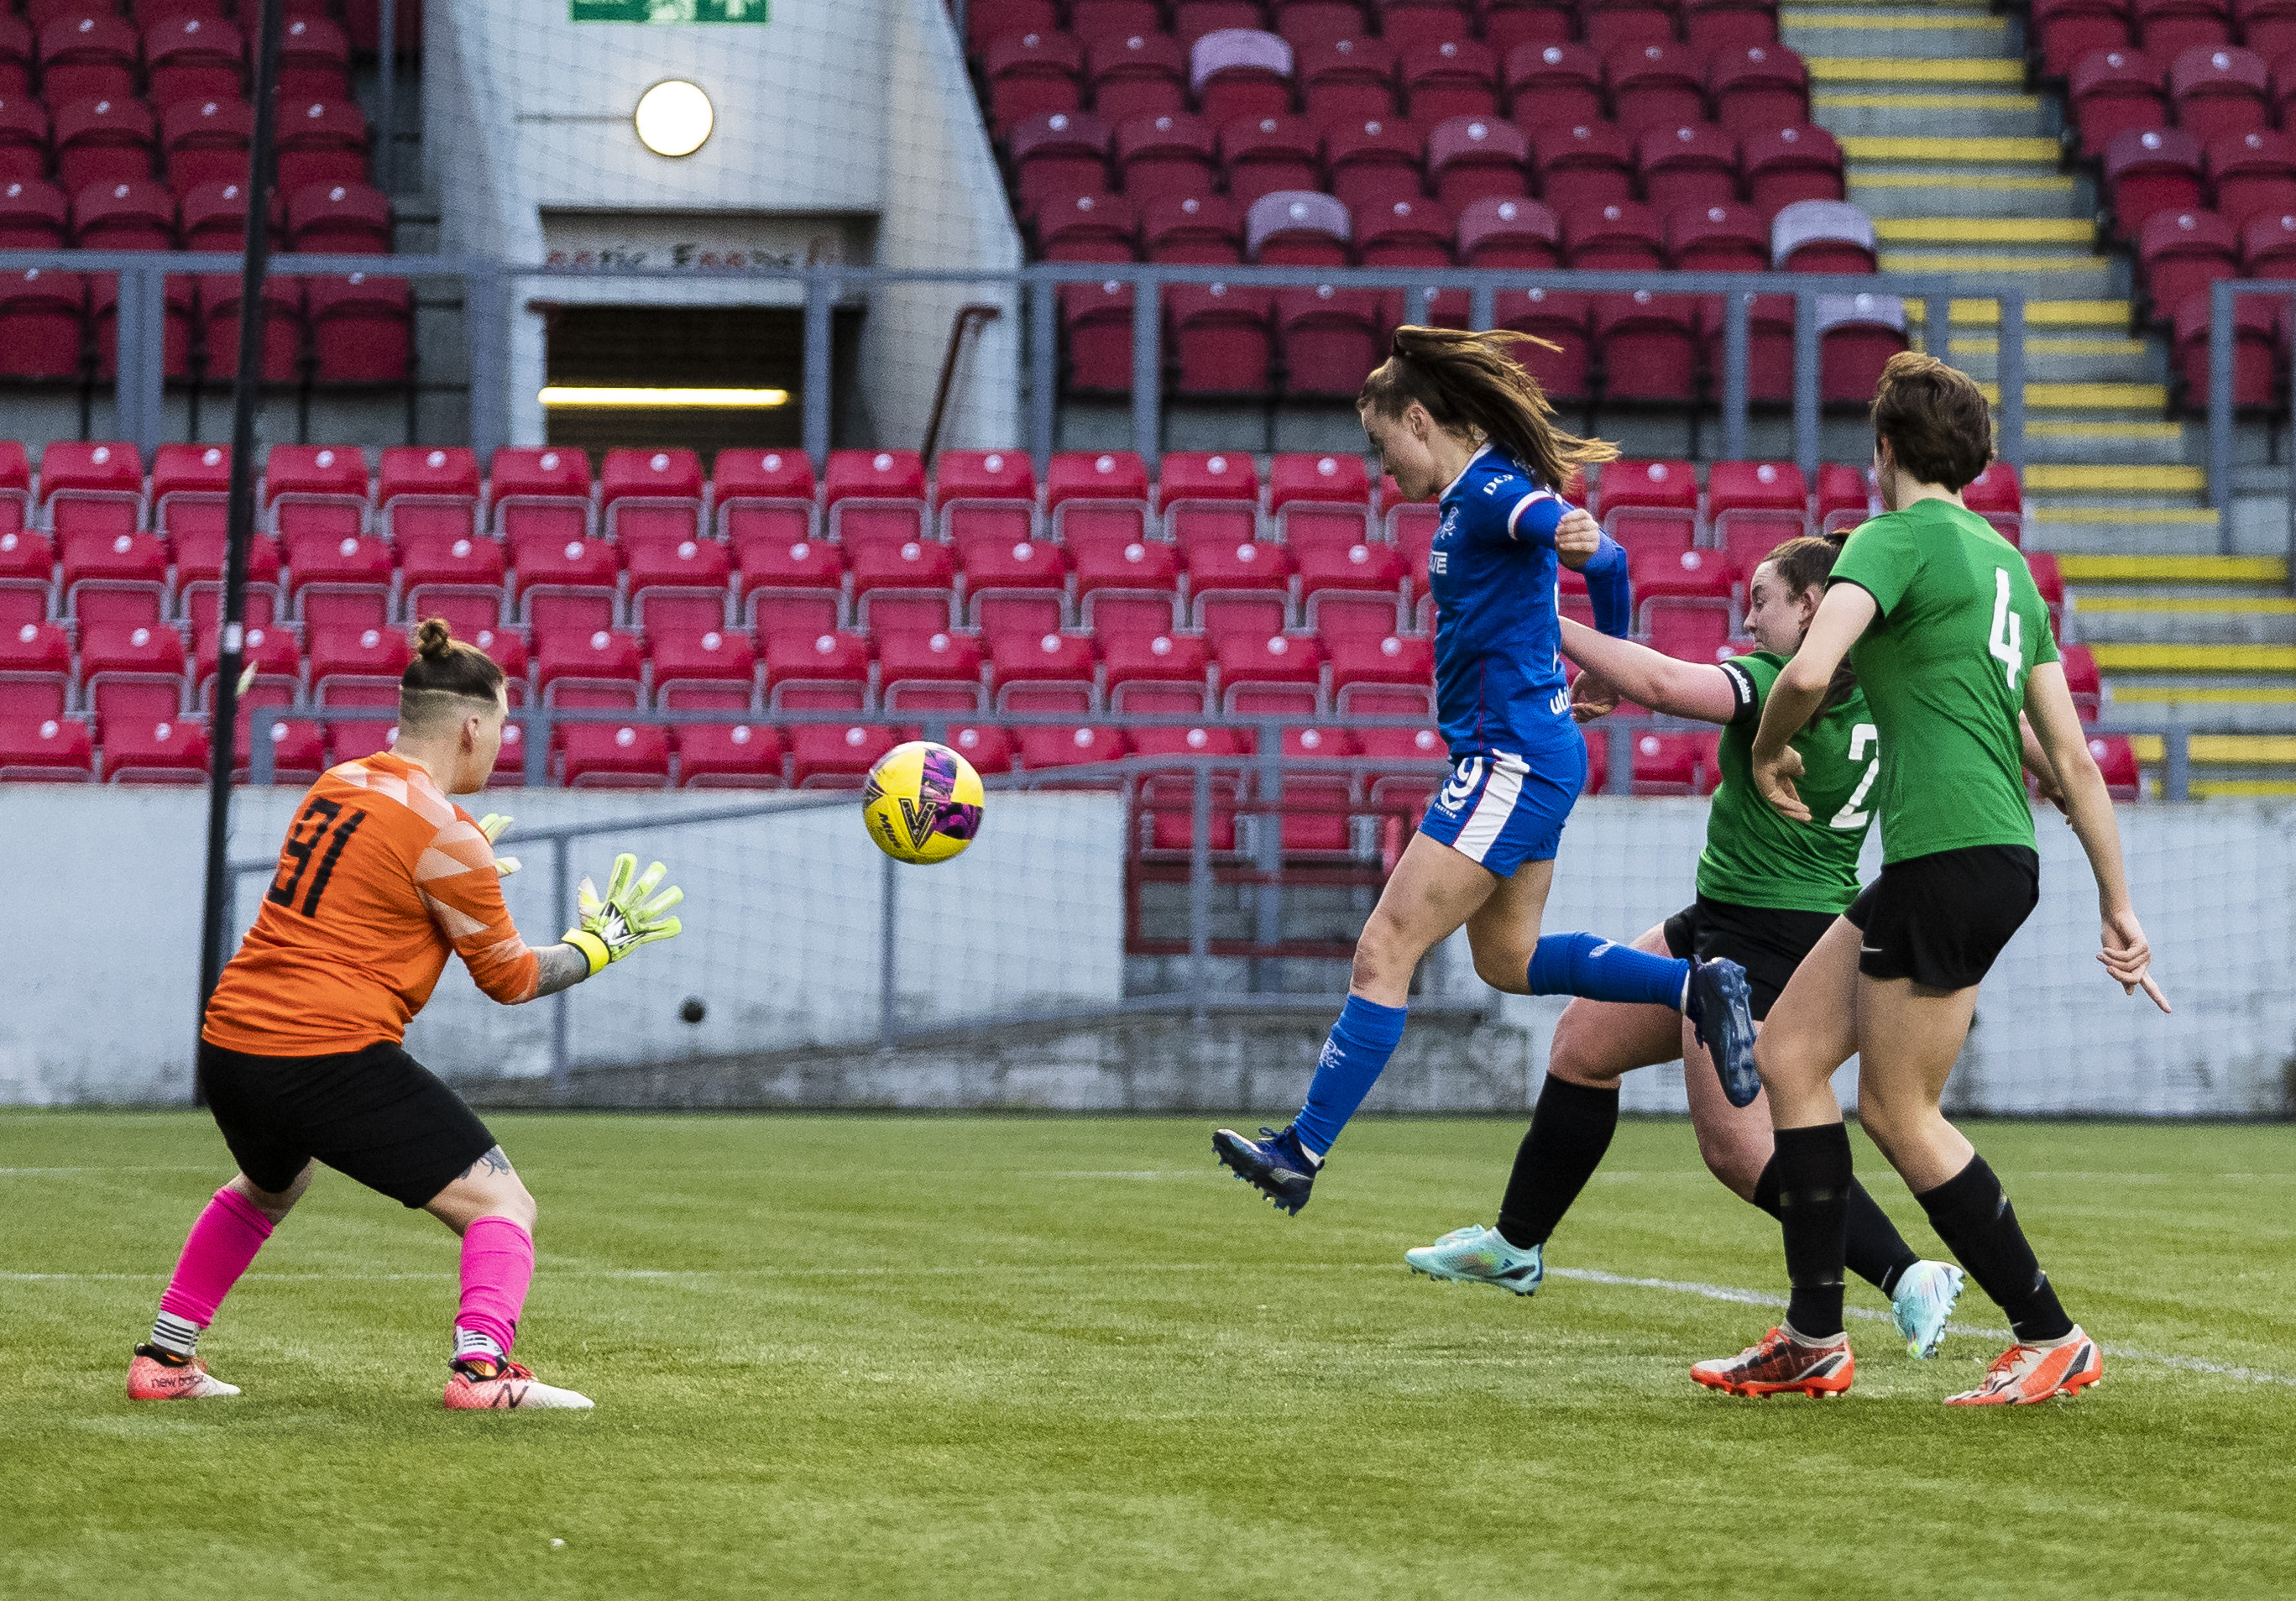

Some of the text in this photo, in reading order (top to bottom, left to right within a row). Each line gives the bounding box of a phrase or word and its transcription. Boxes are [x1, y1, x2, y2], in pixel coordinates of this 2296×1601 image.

[1989, 567, 2022, 690] 4
[1448, 756, 1483, 798] 9
[1829, 724, 1880, 829] 2
